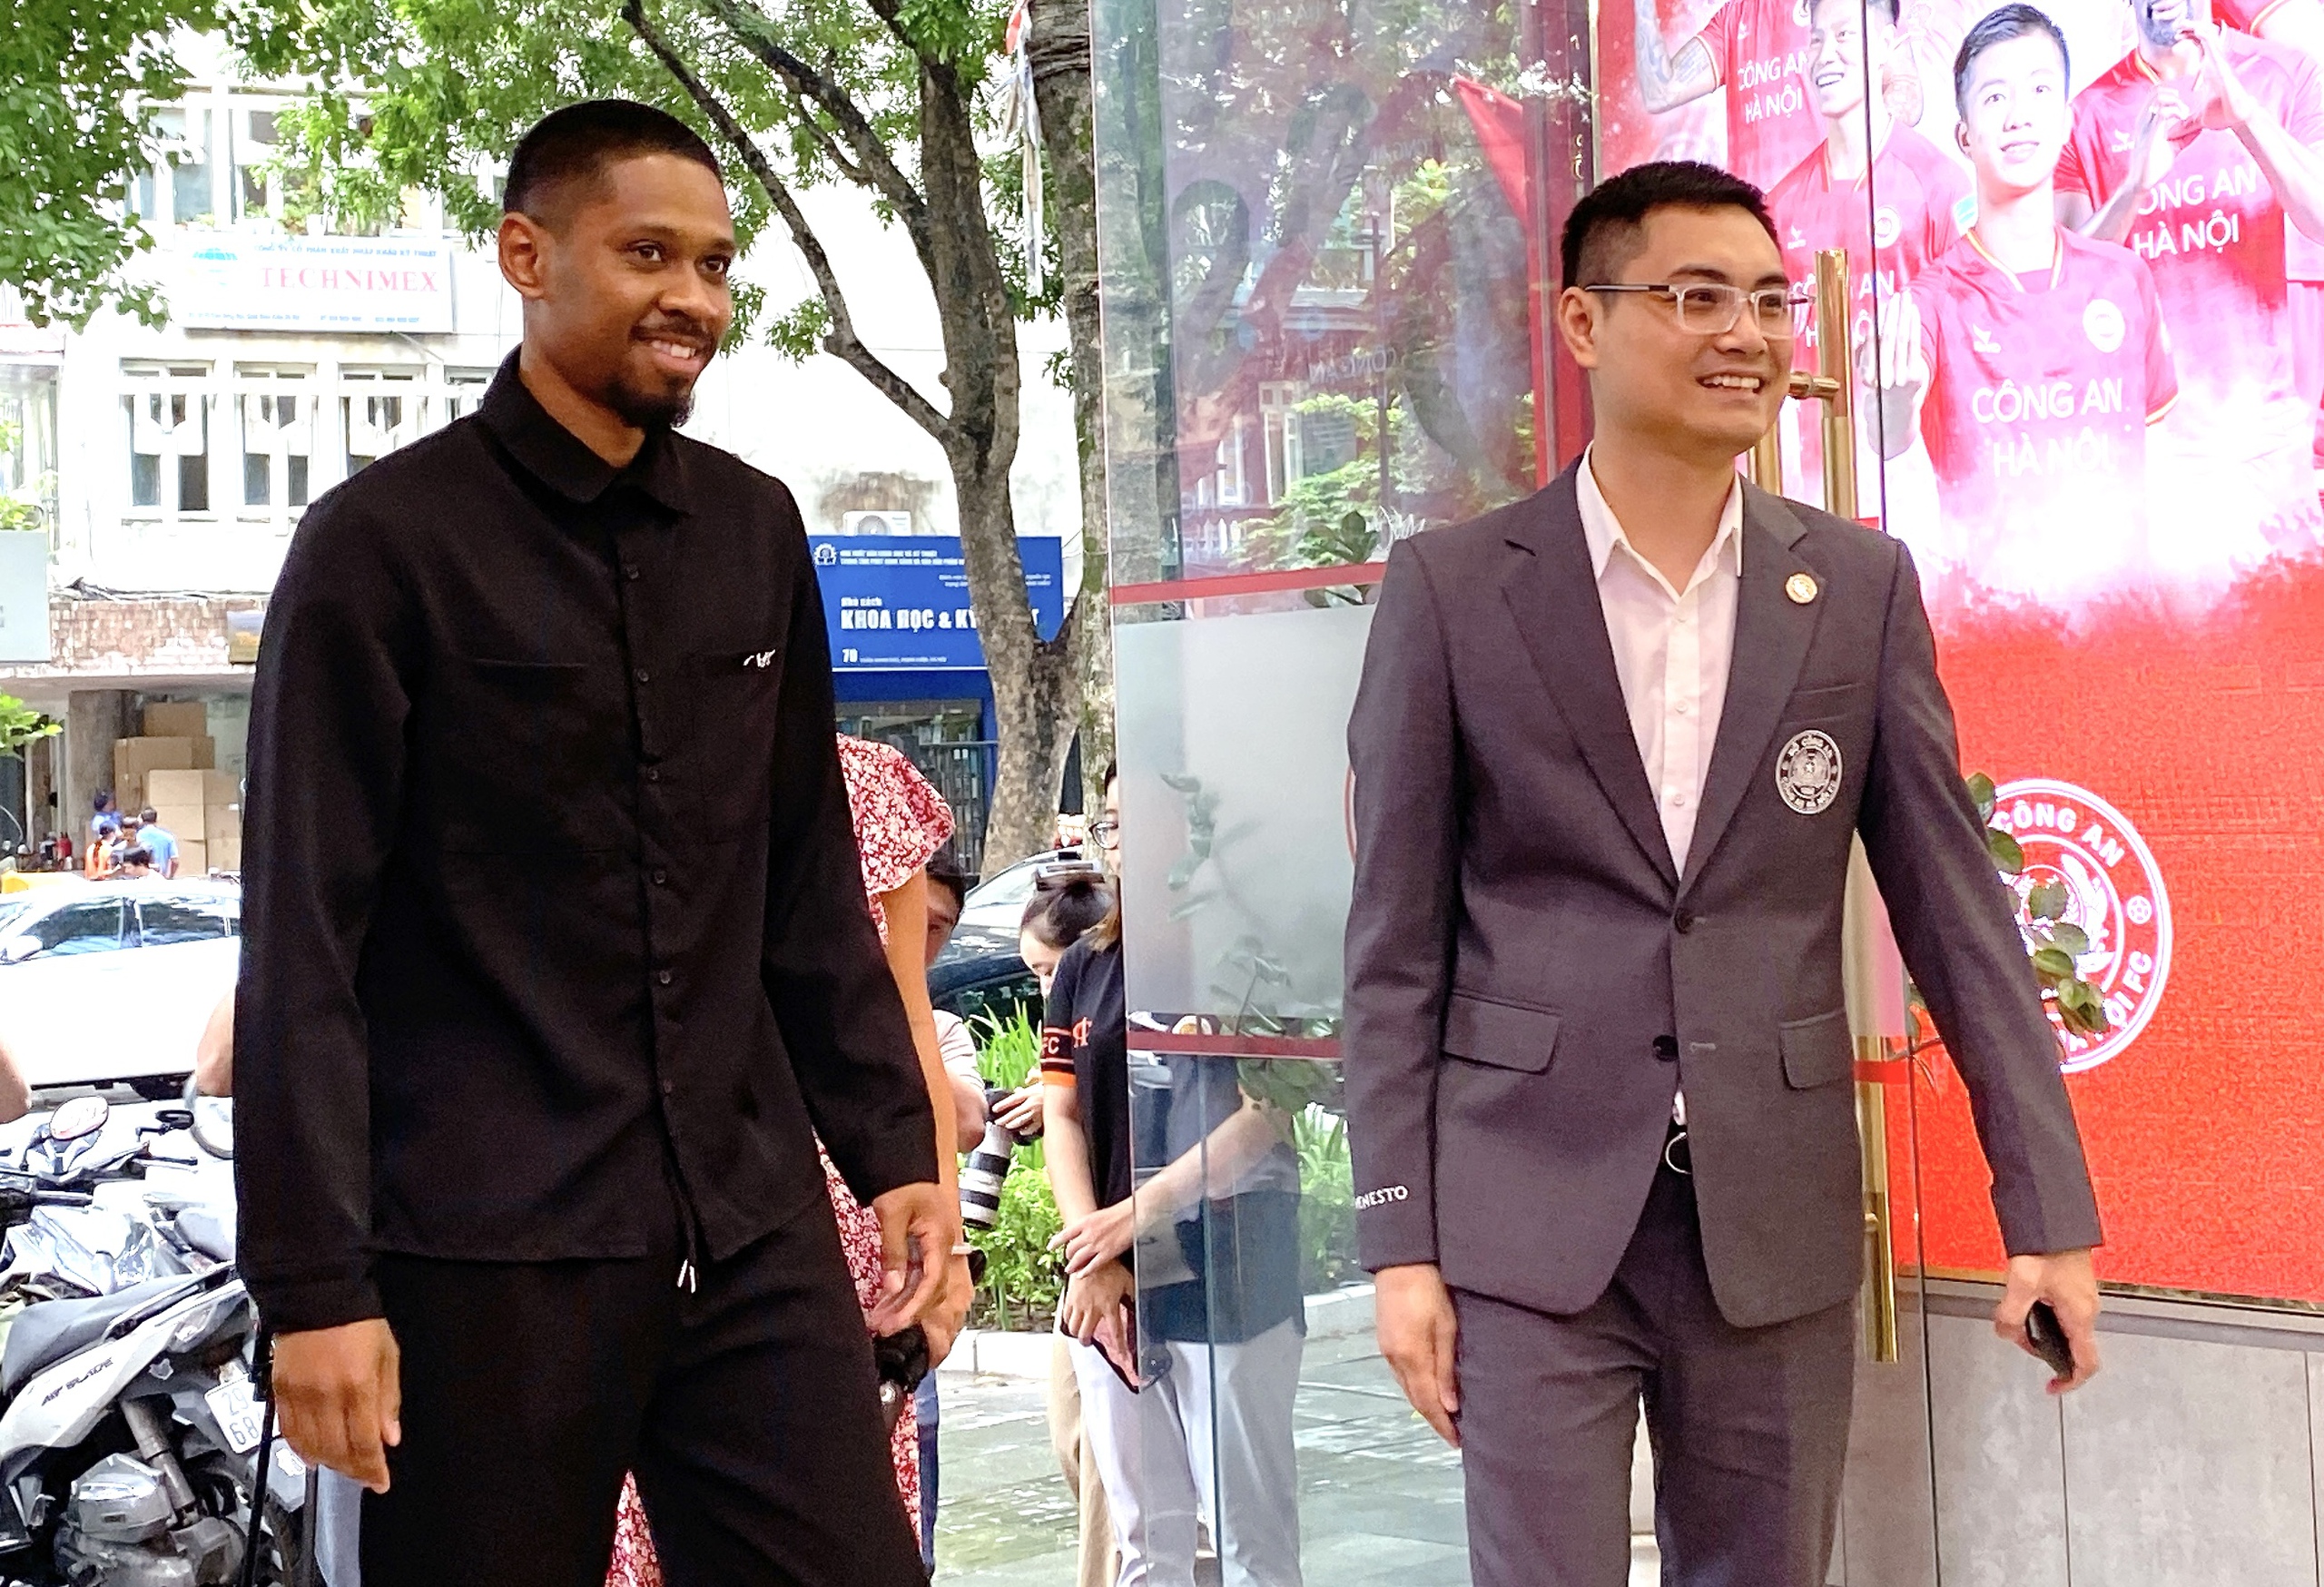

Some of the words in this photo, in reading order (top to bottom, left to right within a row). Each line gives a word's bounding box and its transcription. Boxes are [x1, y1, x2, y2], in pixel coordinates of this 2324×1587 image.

[1745, 93, 1763, 123] HÀ
[1766, 84, 1802, 118] NỘI
[2212, 164, 2257, 200] AN
[2133, 221, 2178, 260] HÀ
[2182, 209, 2240, 254] NỘI
[261, 268, 438, 291] TECHNIMEX
[1972, 378, 2074, 424] CÔNG
[2081, 377, 2122, 416] AN
[1994, 431, 2043, 478] HÀ
[841, 609, 892, 629] KHOA
[897, 609, 934, 633] HỌC
[939, 611, 952, 629] &
[842, 648, 858, 663] 70
[1988, 799, 2078, 834] CÔNG
[2082, 824, 2125, 868] AN
[2122, 951, 2153, 994] FC
[230, 1412, 261, 1445] 68
